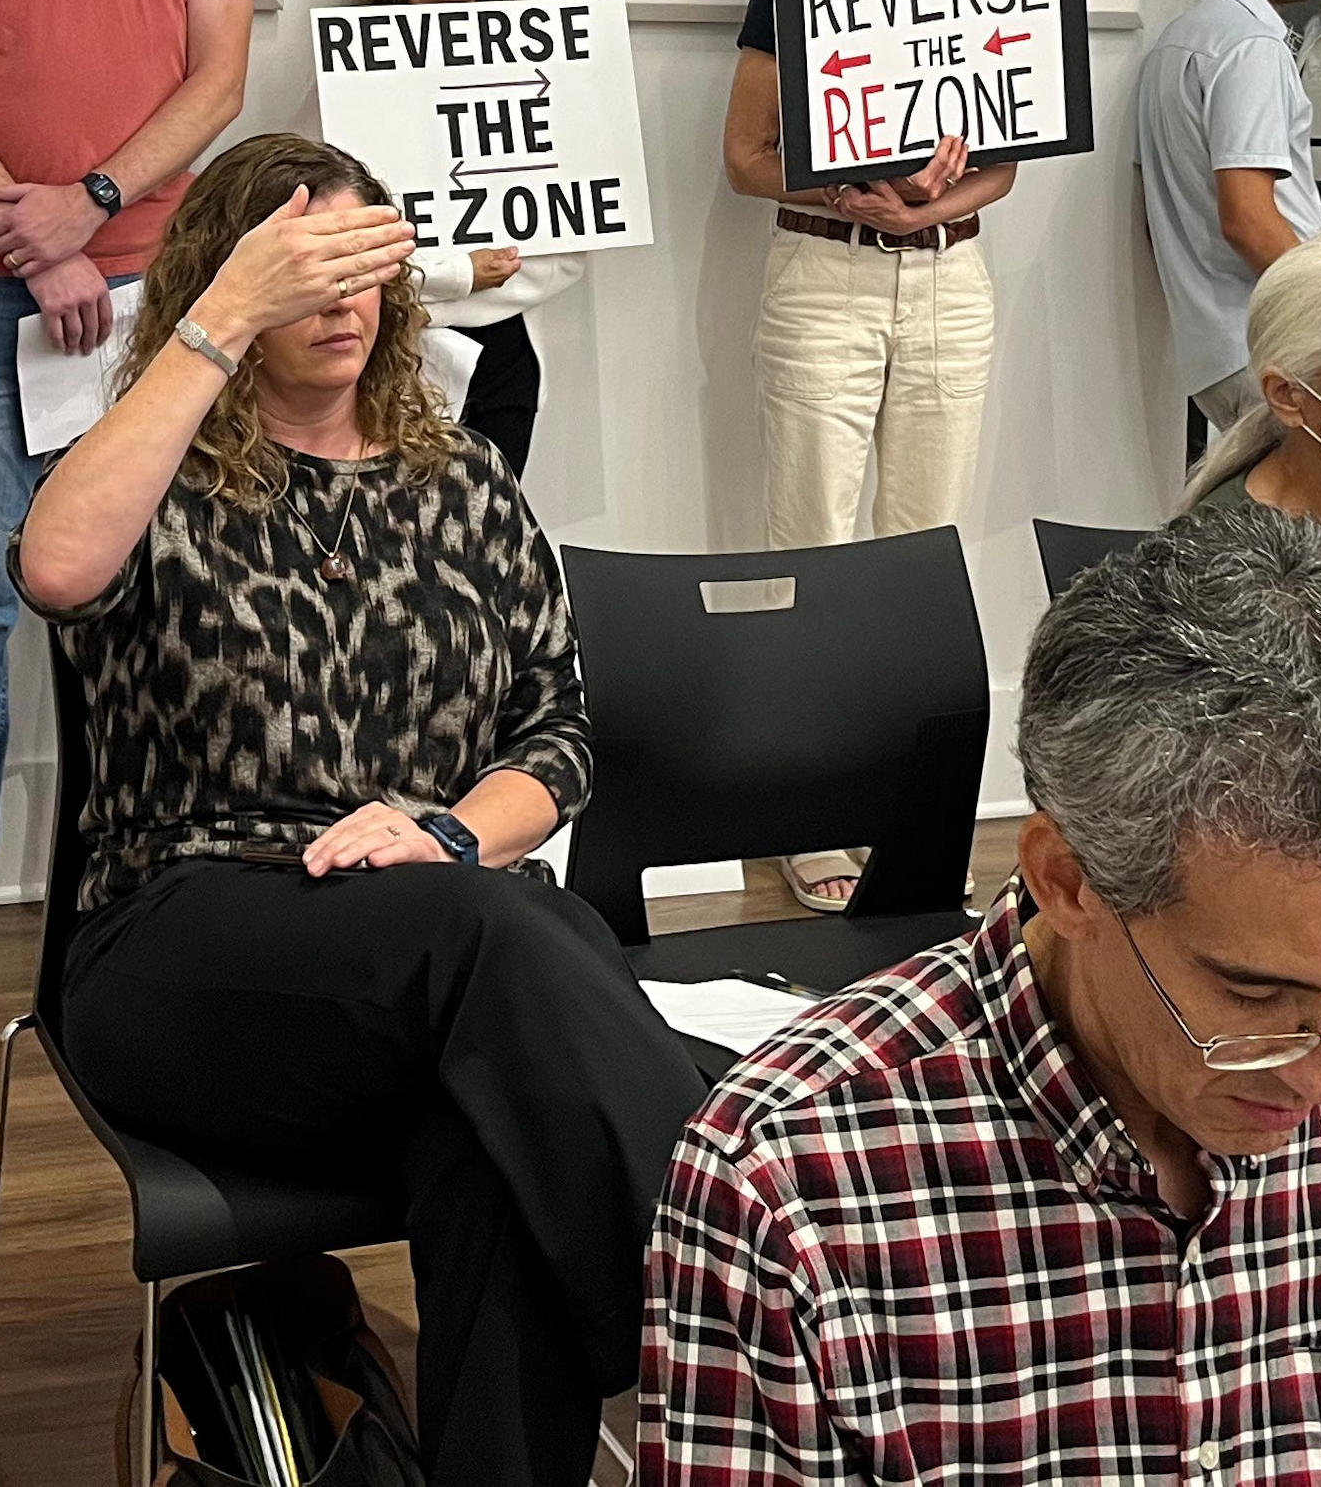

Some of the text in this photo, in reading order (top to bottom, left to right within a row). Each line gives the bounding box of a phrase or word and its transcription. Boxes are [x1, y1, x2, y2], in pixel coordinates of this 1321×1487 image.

[318, 6, 590, 72] REVERSE
[903, 34, 966, 68] THE
[436, 97, 553, 158] THE
[823, 67, 1039, 163] REZONE
[402, 178, 626, 248] EZONE
